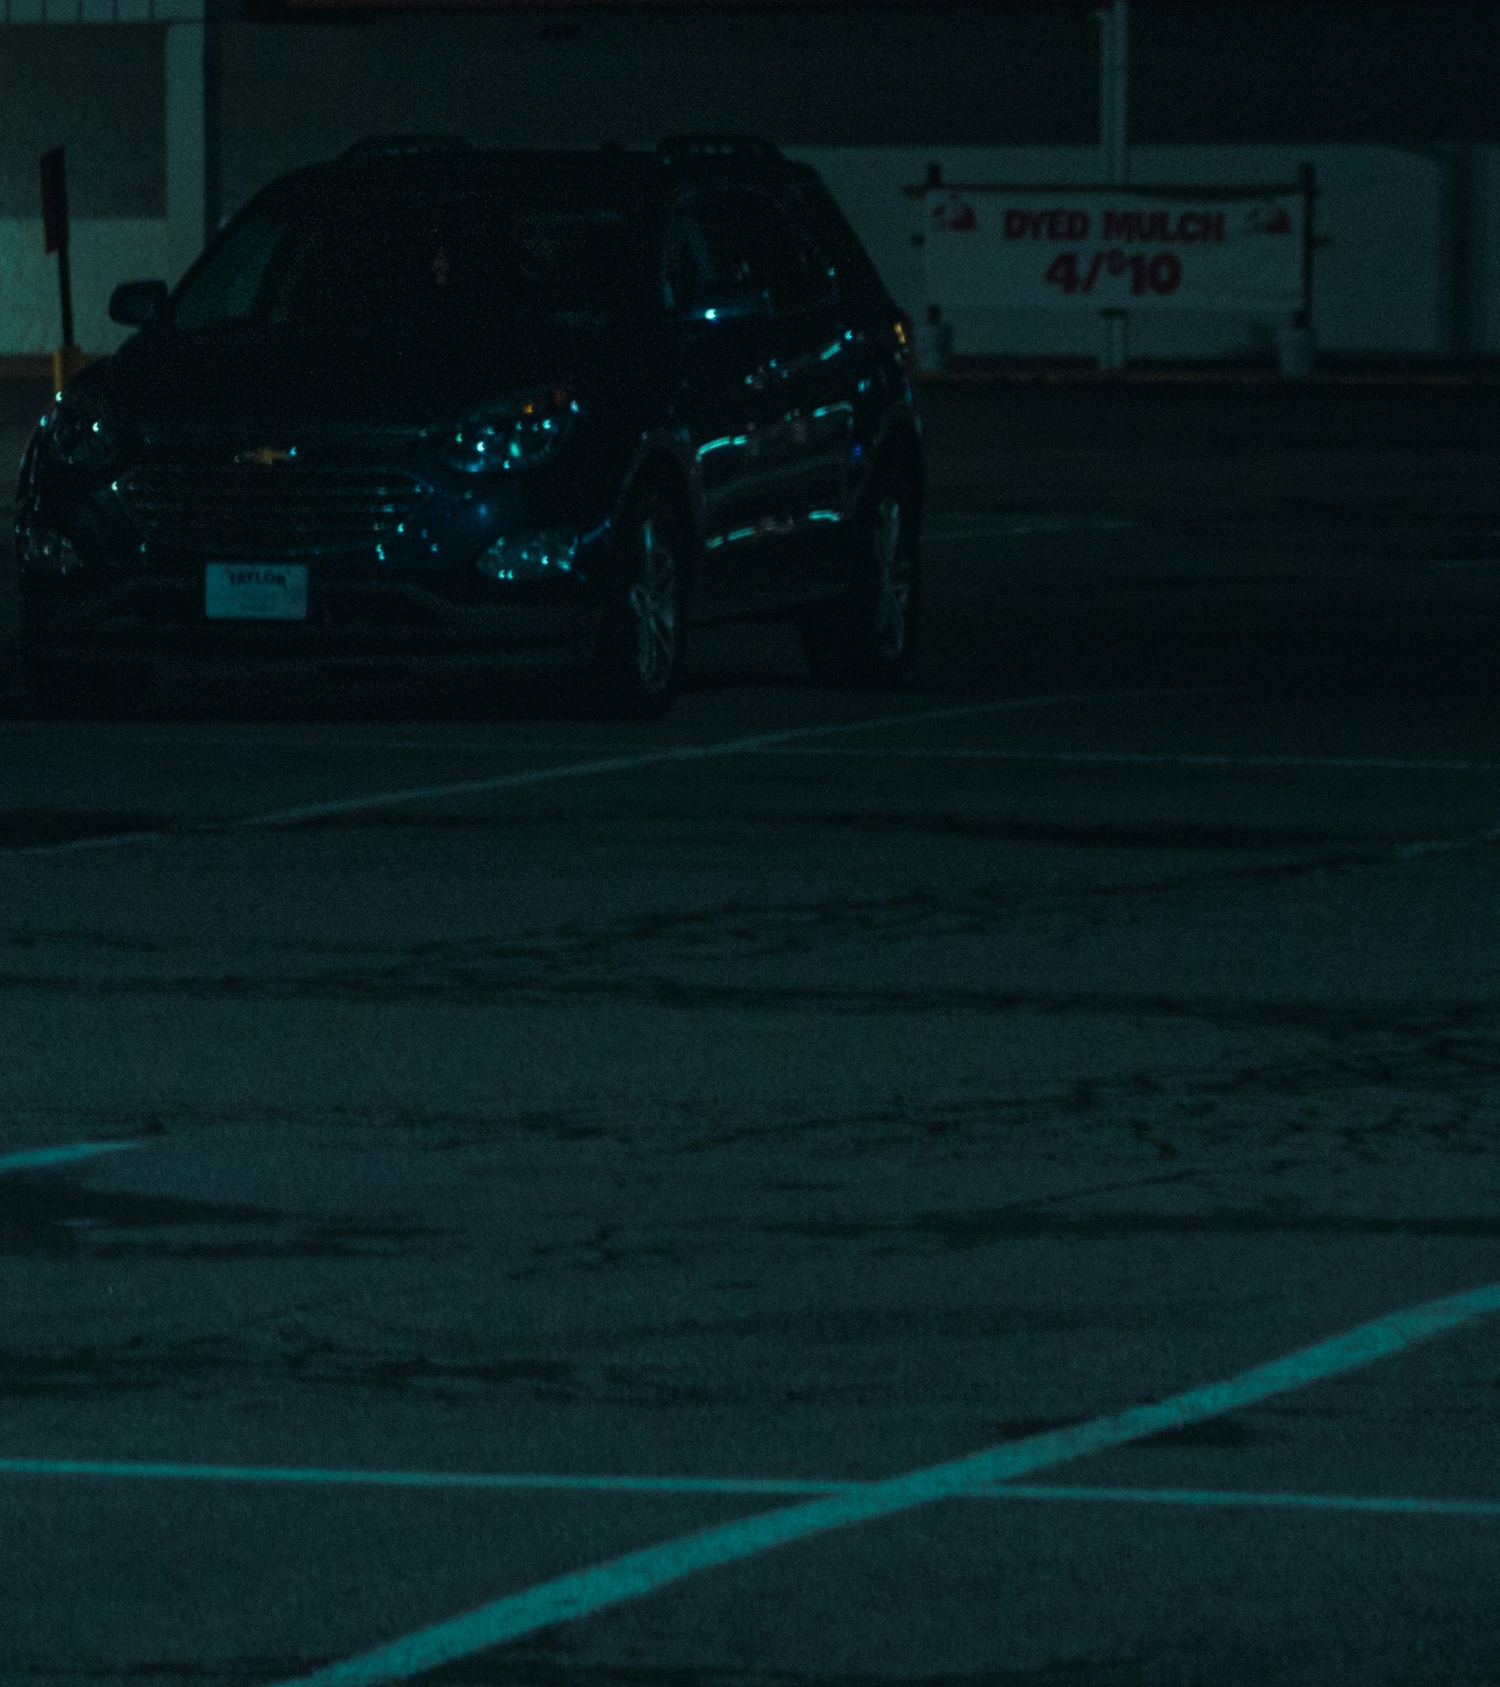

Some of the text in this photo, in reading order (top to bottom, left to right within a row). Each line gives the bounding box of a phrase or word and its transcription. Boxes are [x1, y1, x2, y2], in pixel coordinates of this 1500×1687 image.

[1004, 210, 1224, 242] DYED MULCH
[1046, 248, 1181, 294] 4/$10
